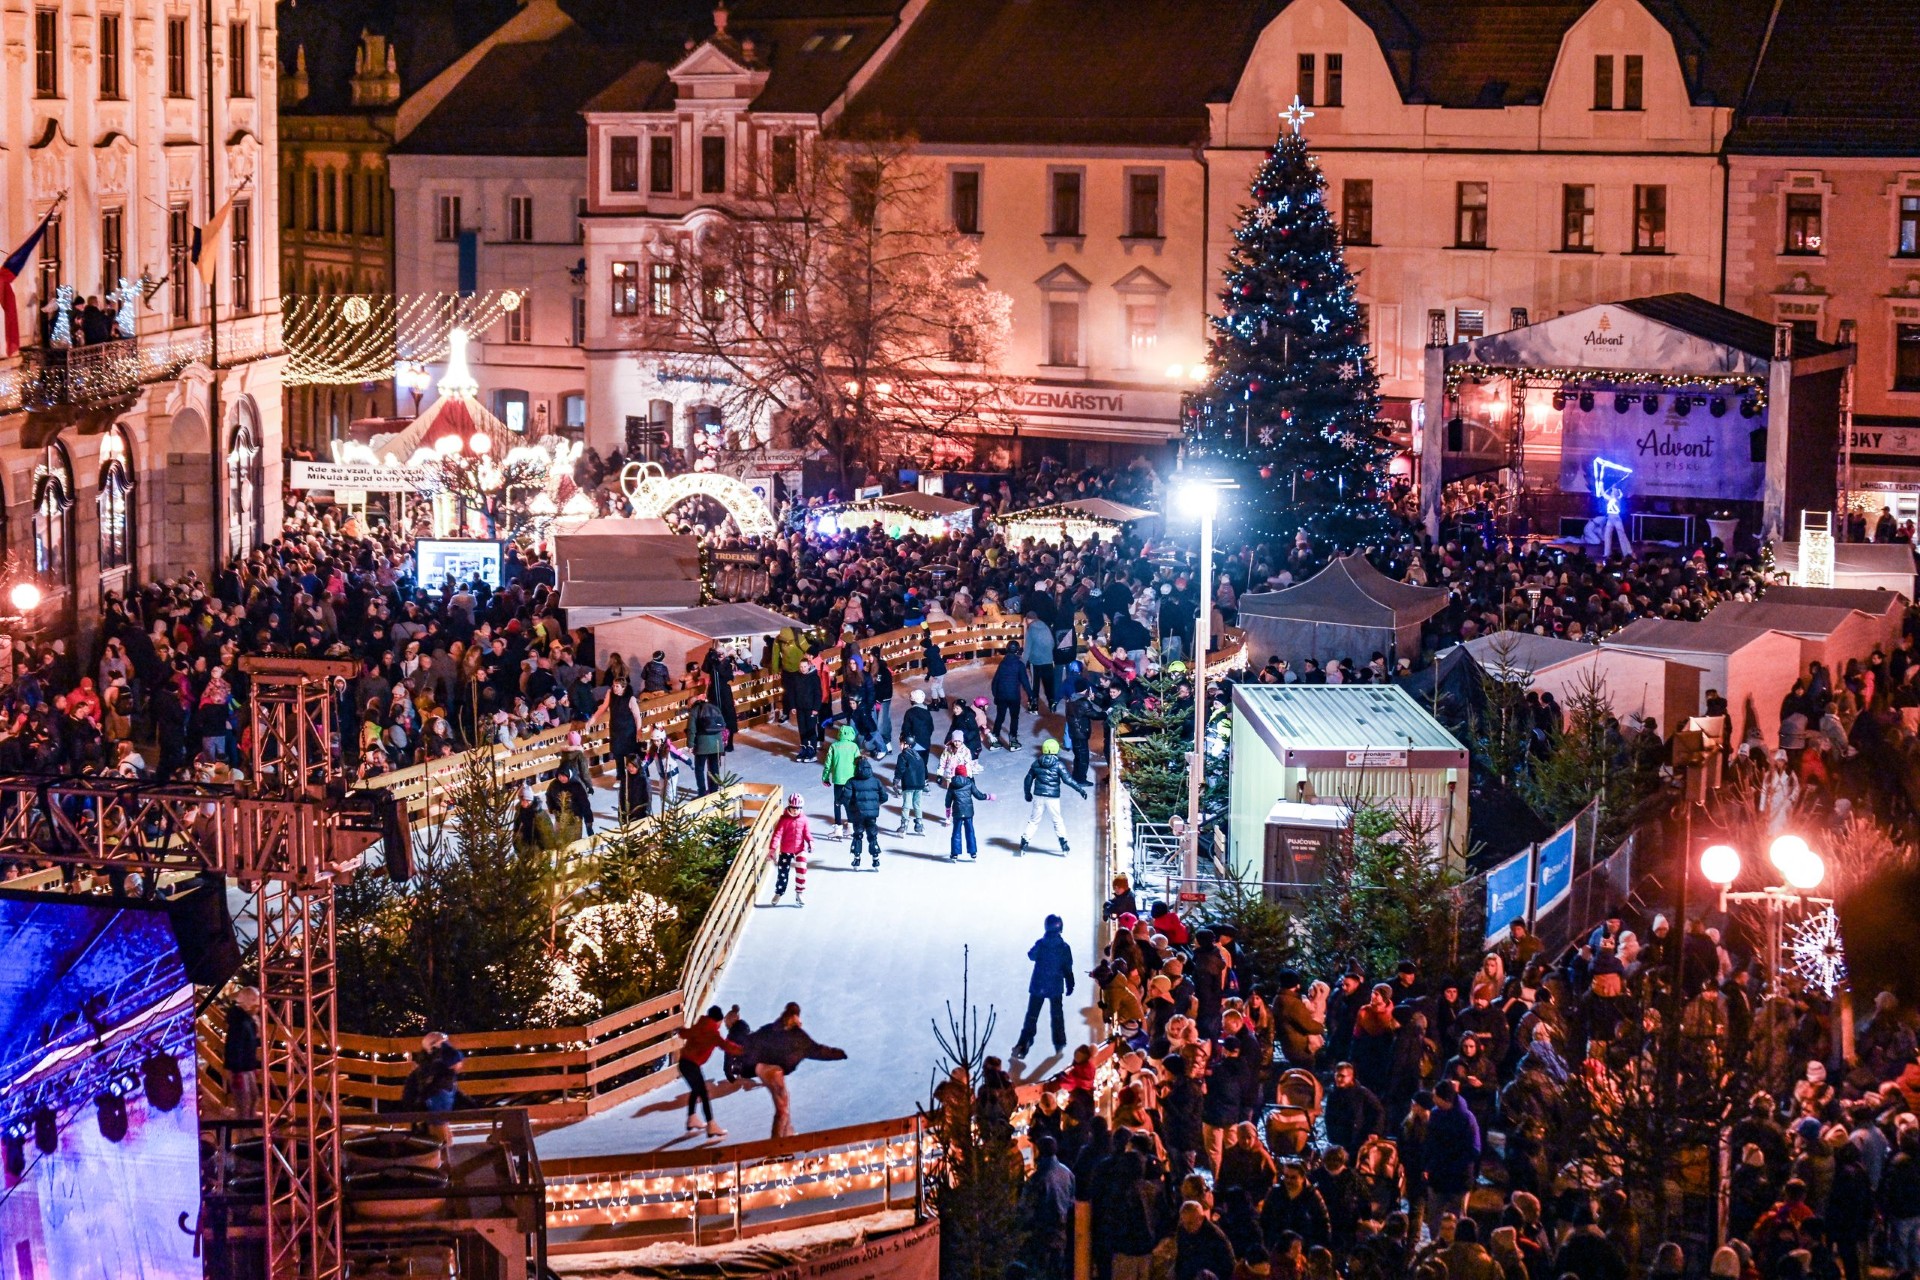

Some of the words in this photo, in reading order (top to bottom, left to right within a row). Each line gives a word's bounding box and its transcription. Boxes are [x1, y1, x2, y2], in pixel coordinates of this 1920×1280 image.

[1584, 330, 1624, 345] Advent
[1636, 429, 1715, 457] Advent
[307, 465, 327, 473] Kde
[1666, 461, 1700, 471] PÍSKU
[307, 473, 349, 481] Mikuláš
[353, 474, 372, 482] pod
[714, 552, 756, 561] TRDELNÍK
[819, 1256, 859, 1278] prosince
[862, 1245, 884, 1262] 2024
